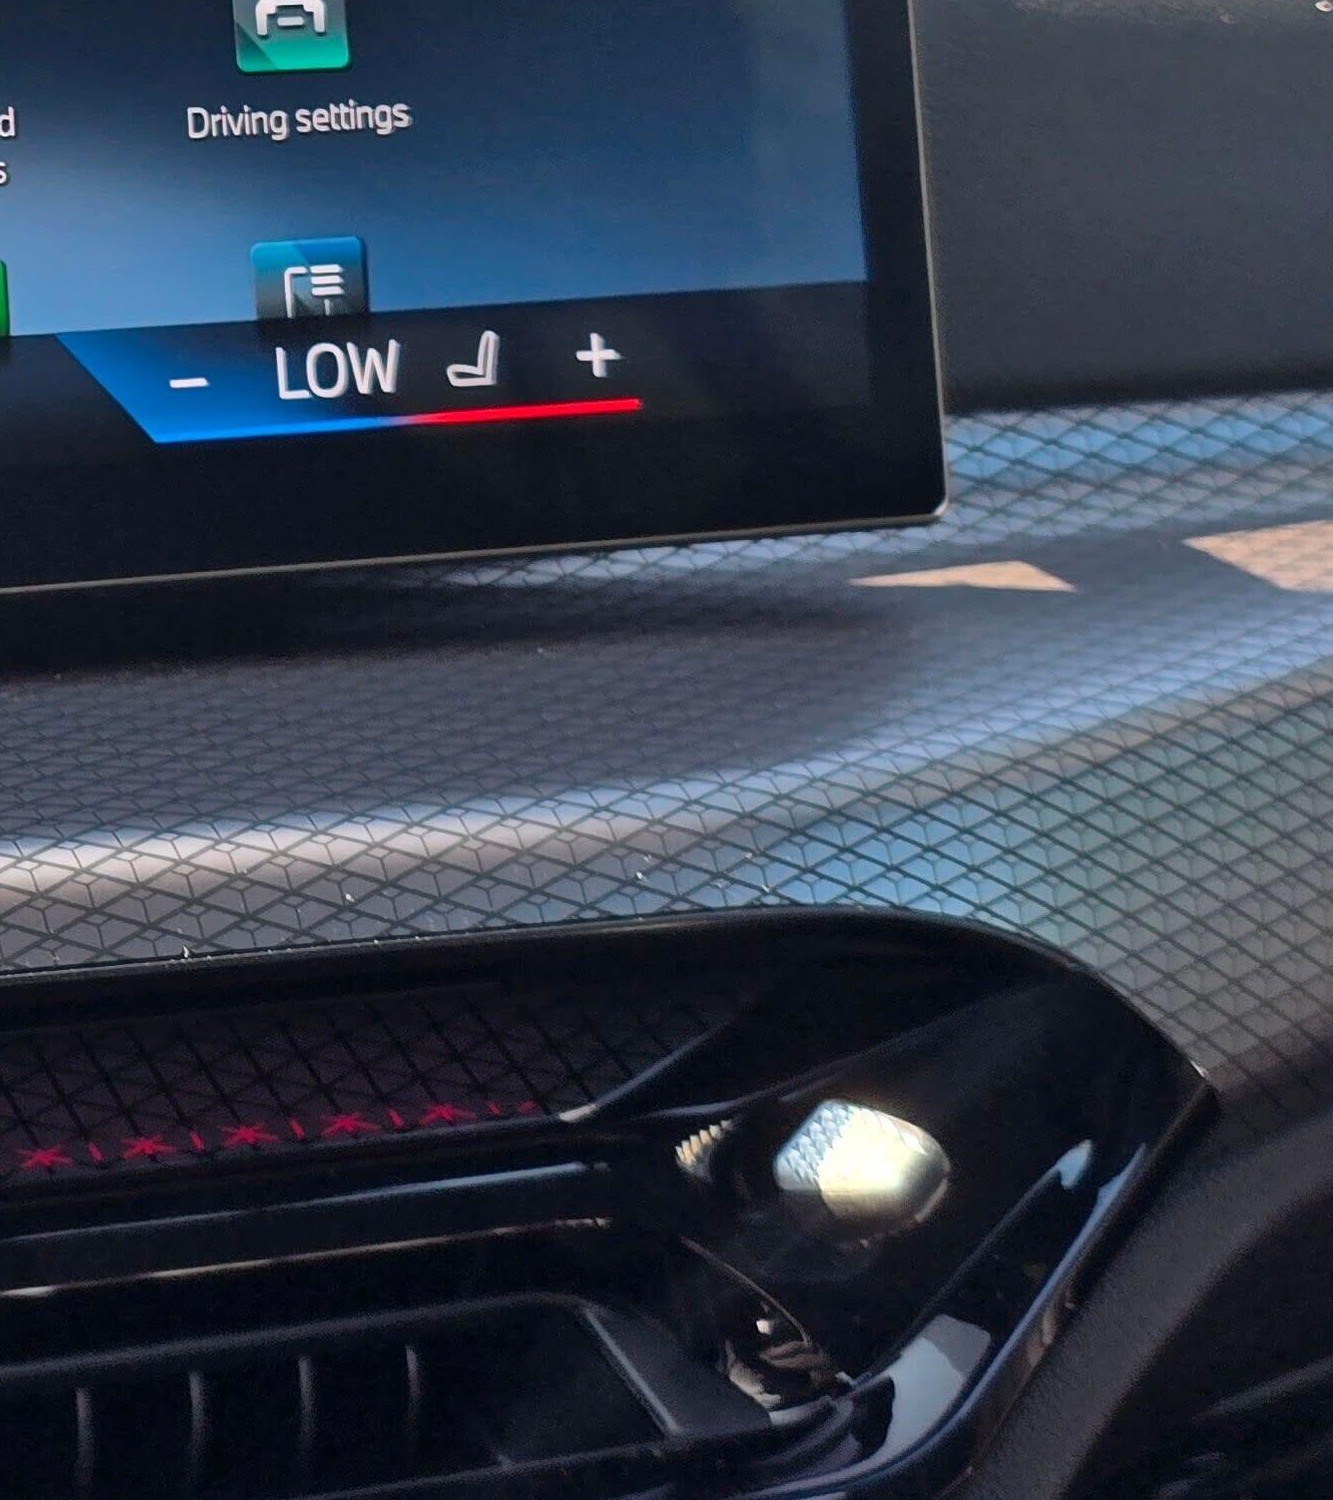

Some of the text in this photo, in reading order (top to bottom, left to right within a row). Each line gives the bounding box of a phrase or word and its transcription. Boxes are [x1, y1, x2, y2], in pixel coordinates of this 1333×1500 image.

[187, 98, 412, 141] Driving settings
[275, 339, 400, 400] LOW
